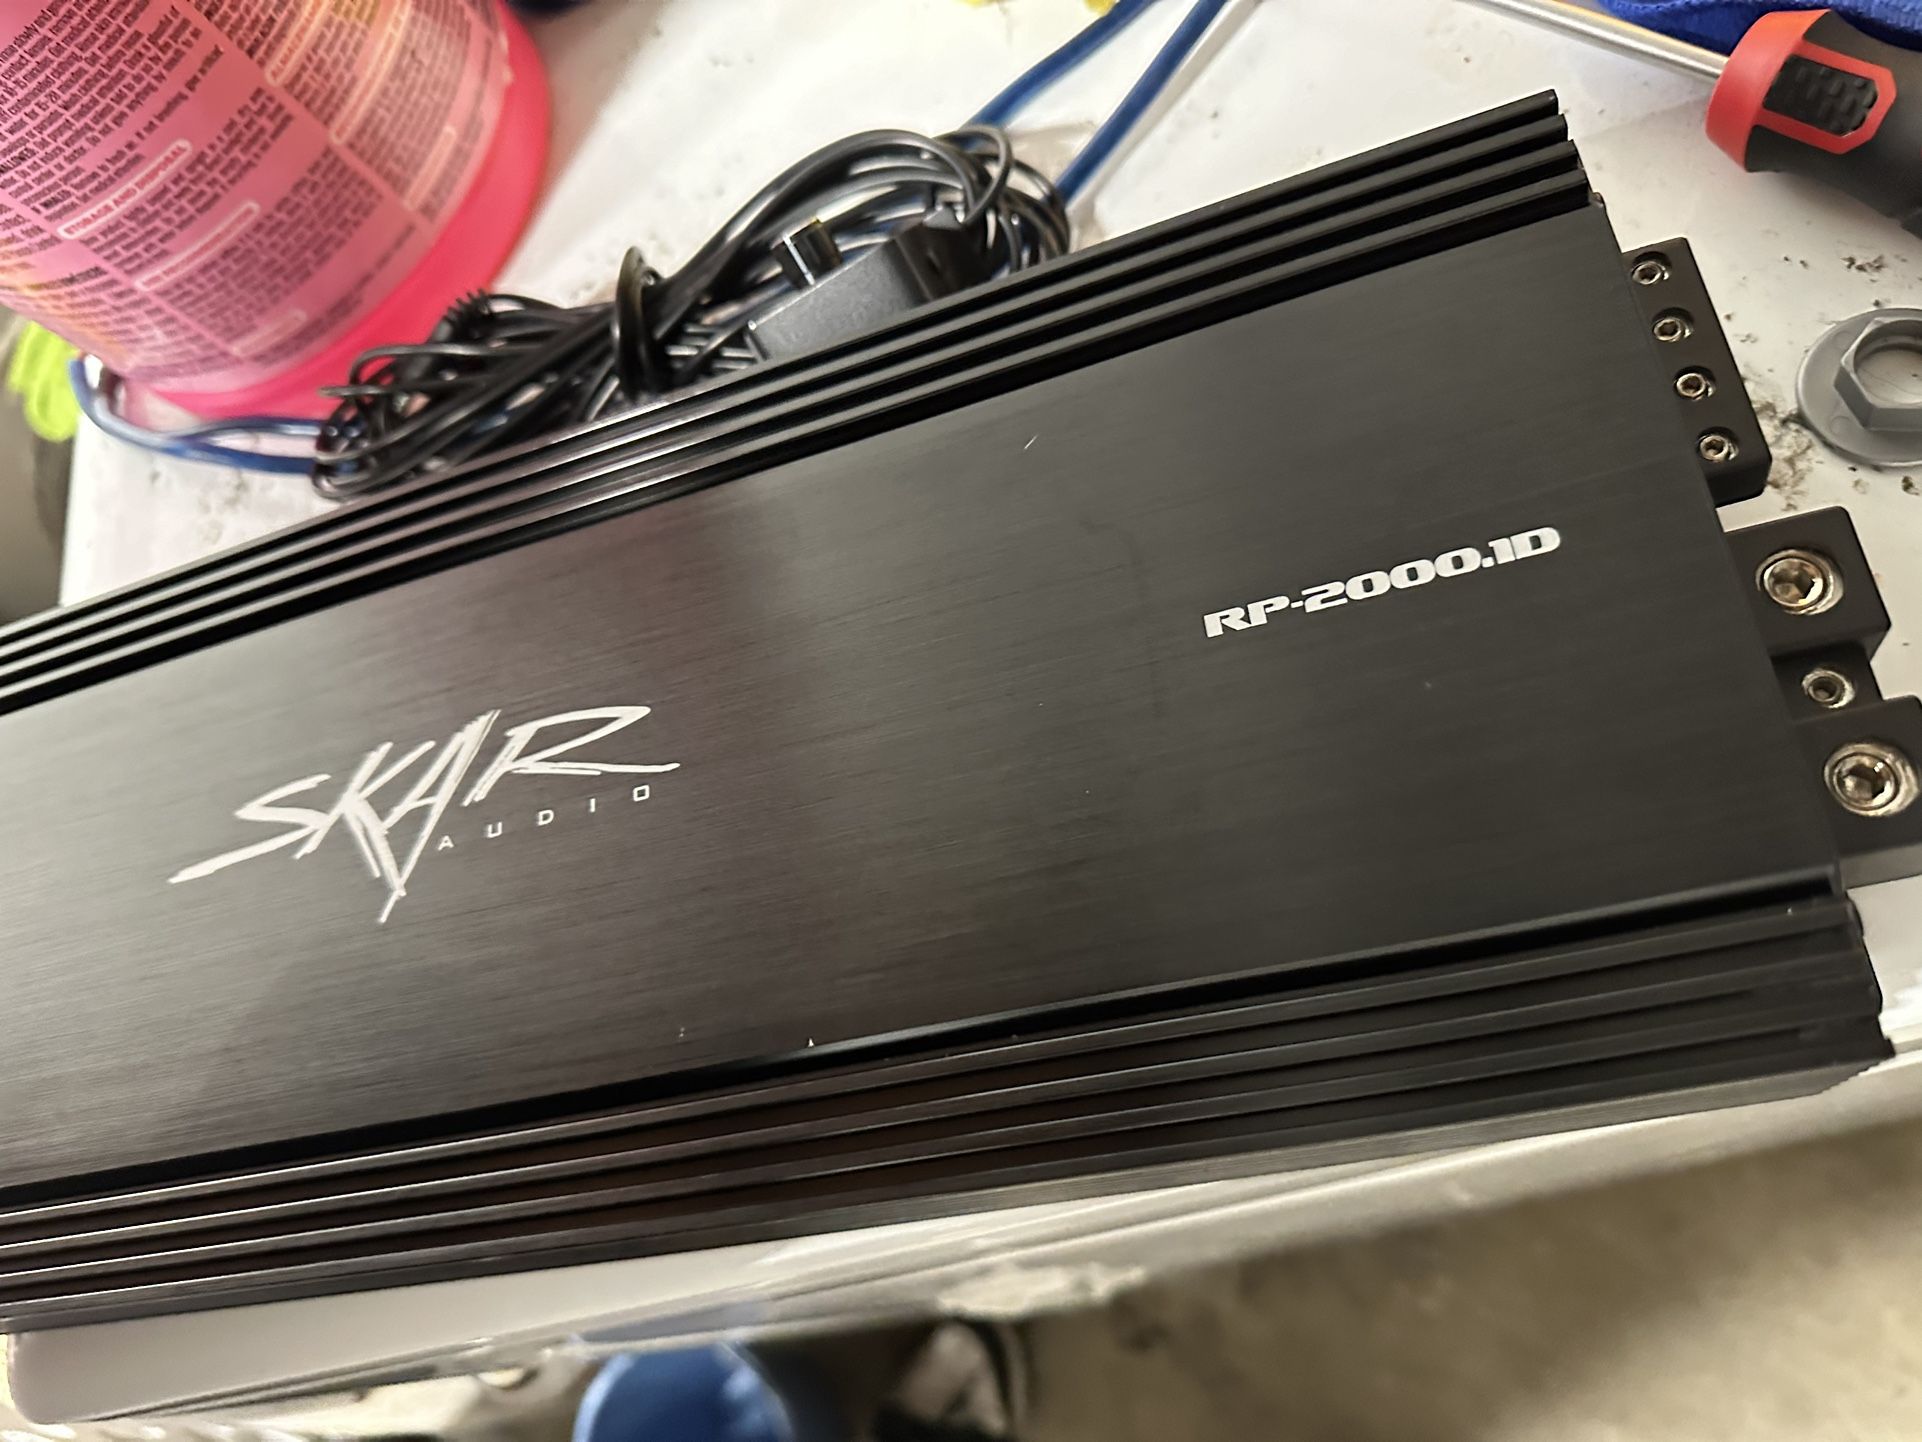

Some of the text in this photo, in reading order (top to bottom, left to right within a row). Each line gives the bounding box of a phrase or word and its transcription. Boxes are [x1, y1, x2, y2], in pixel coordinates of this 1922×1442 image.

[1204, 527, 1561, 638] RP-2000.1D
[168, 706, 680, 923] SKAR
[438, 785, 650, 850] AUDIO
